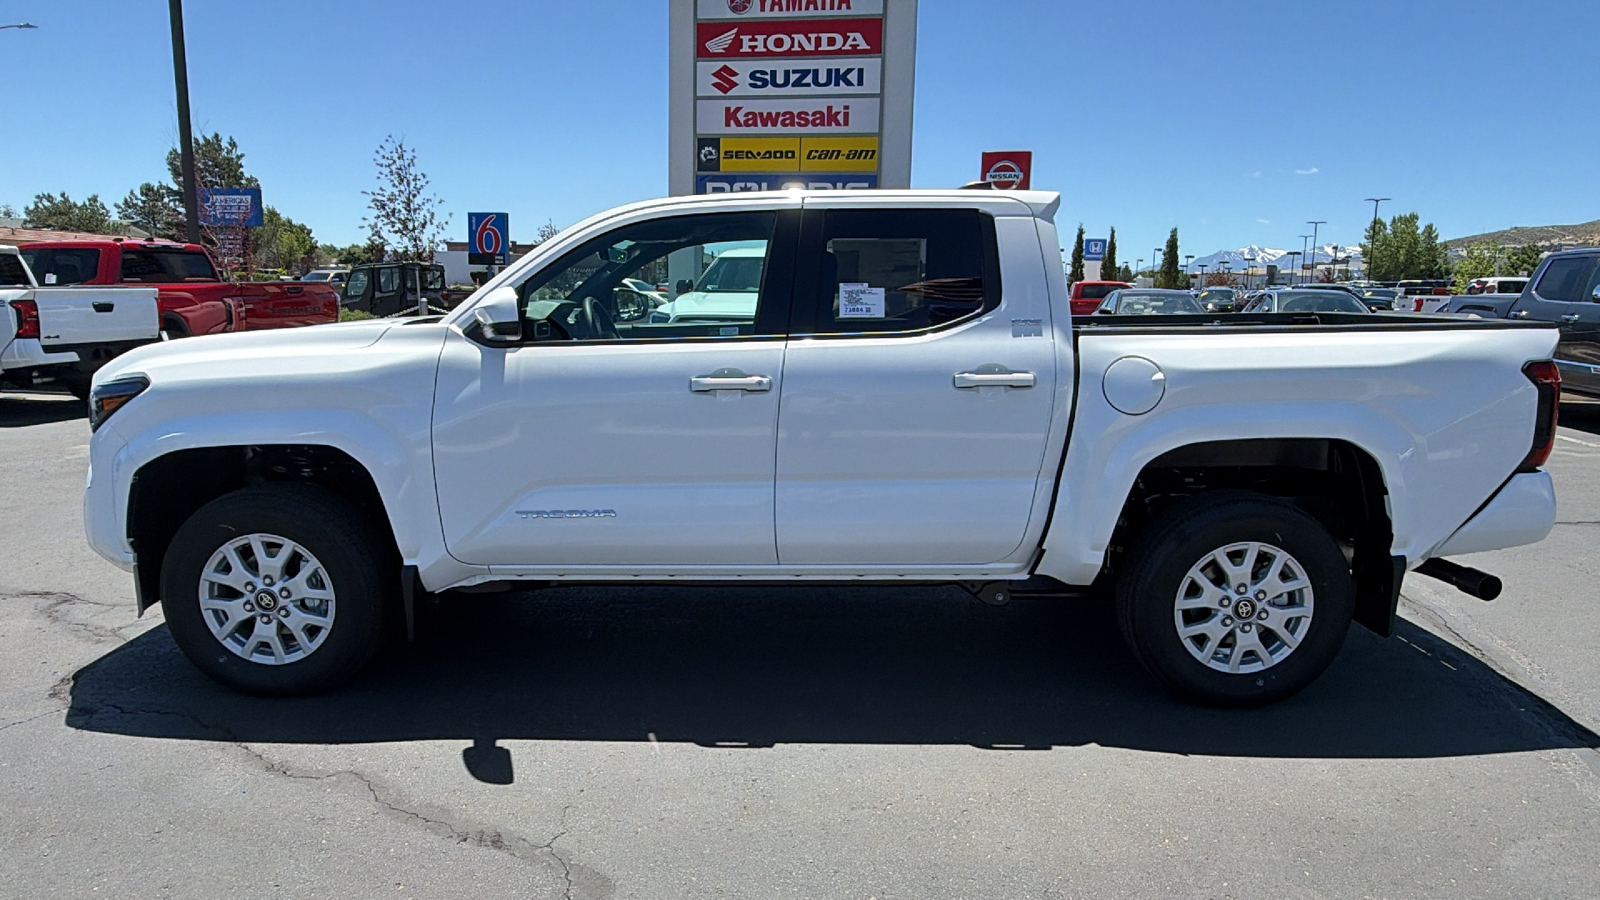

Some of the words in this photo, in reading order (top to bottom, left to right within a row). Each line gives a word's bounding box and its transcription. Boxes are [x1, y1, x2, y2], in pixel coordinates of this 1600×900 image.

[739, 32, 871, 53] HONDA
[748, 67, 865, 89] SUZUKI
[724, 105, 850, 128] Kawasaki
[476, 214, 502, 254] 6
[515, 509, 617, 519] TACOMA
